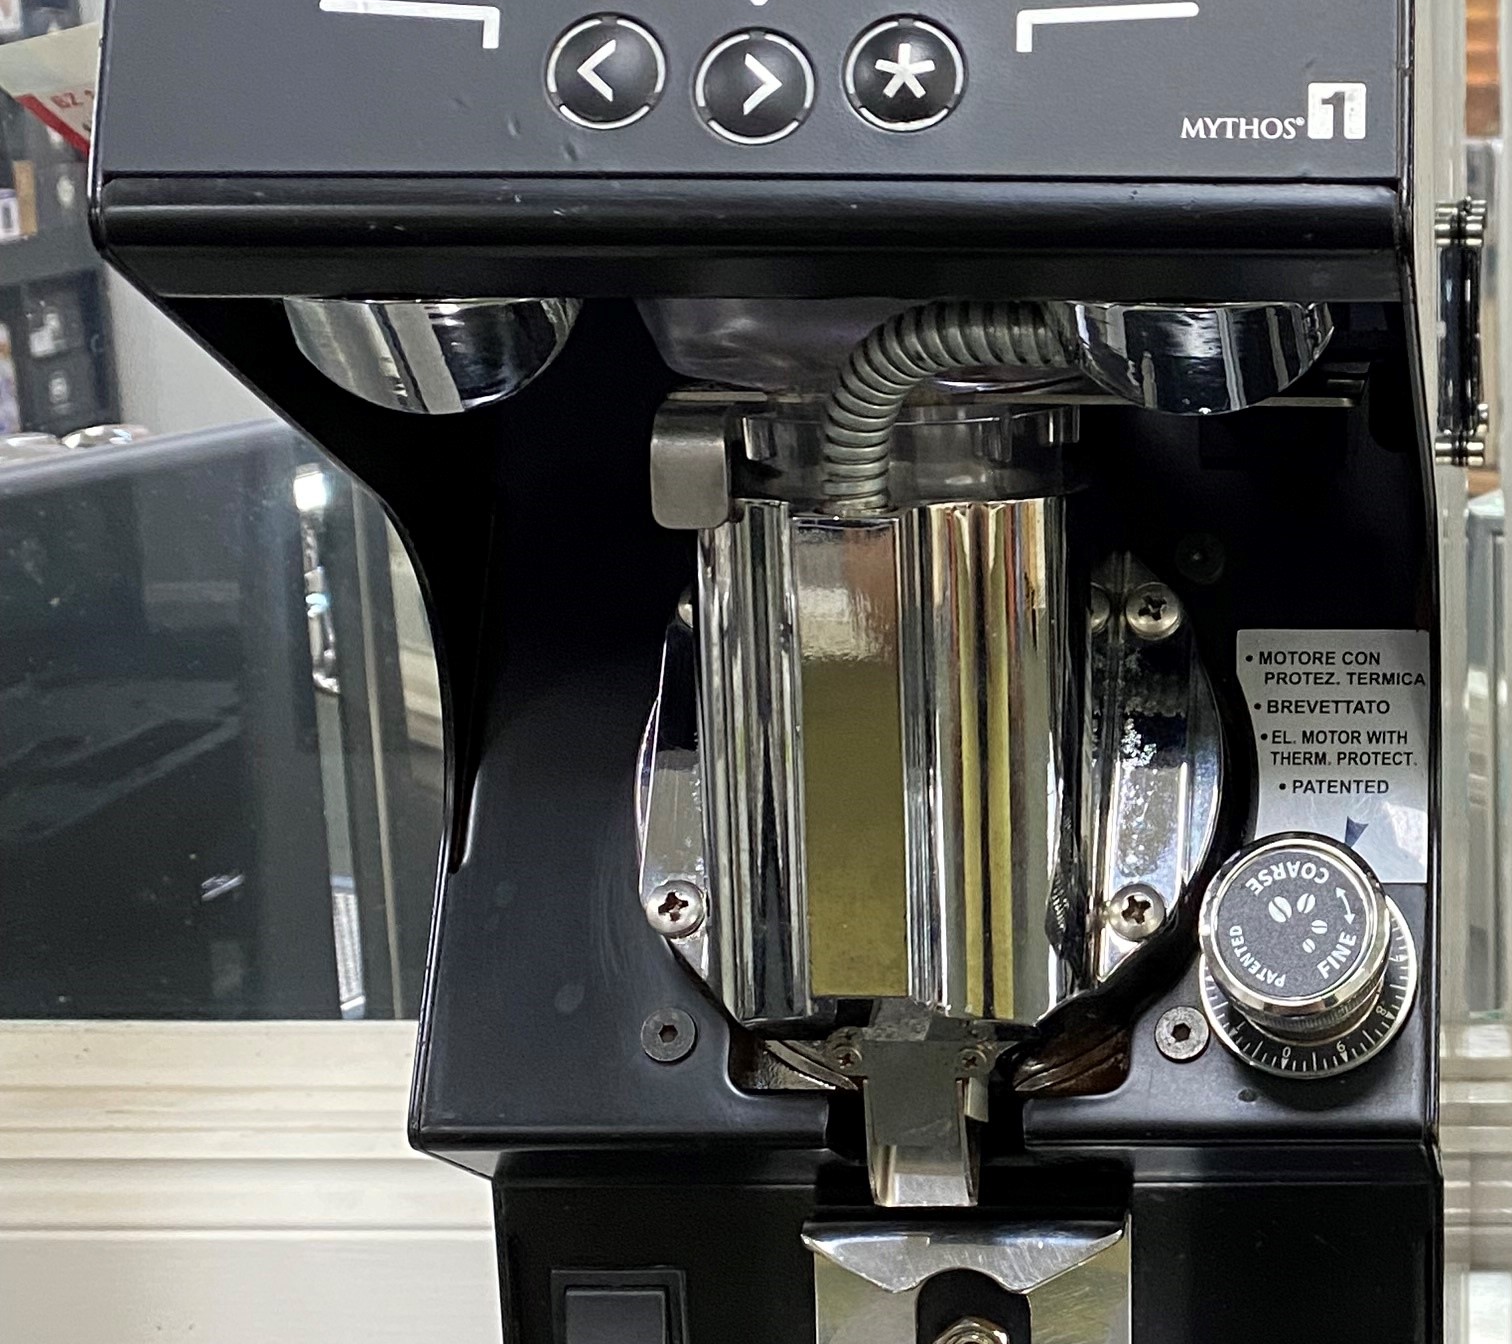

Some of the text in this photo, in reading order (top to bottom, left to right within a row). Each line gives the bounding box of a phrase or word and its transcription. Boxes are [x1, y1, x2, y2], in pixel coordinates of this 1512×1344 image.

[1259, 651, 1380, 665] MOTORE CON
[1264, 672, 1425, 685] PROTEZ. TERMICA
[1267, 700, 1390, 714] BREVETTATO
[1271, 730, 1408, 744] EL. MOTOR WITH
[1270, 751, 1418, 766] THERM. PROTECT.
[1292, 780, 1389, 794] PATENTED
[1245, 860, 1330, 896] COARSE
[1229, 925, 1286, 987] PATENTED
[1316, 930, 1357, 979] FINE
[1375, 1006, 1387, 1017] 8
[1282, 1046, 1292, 1057] 0
